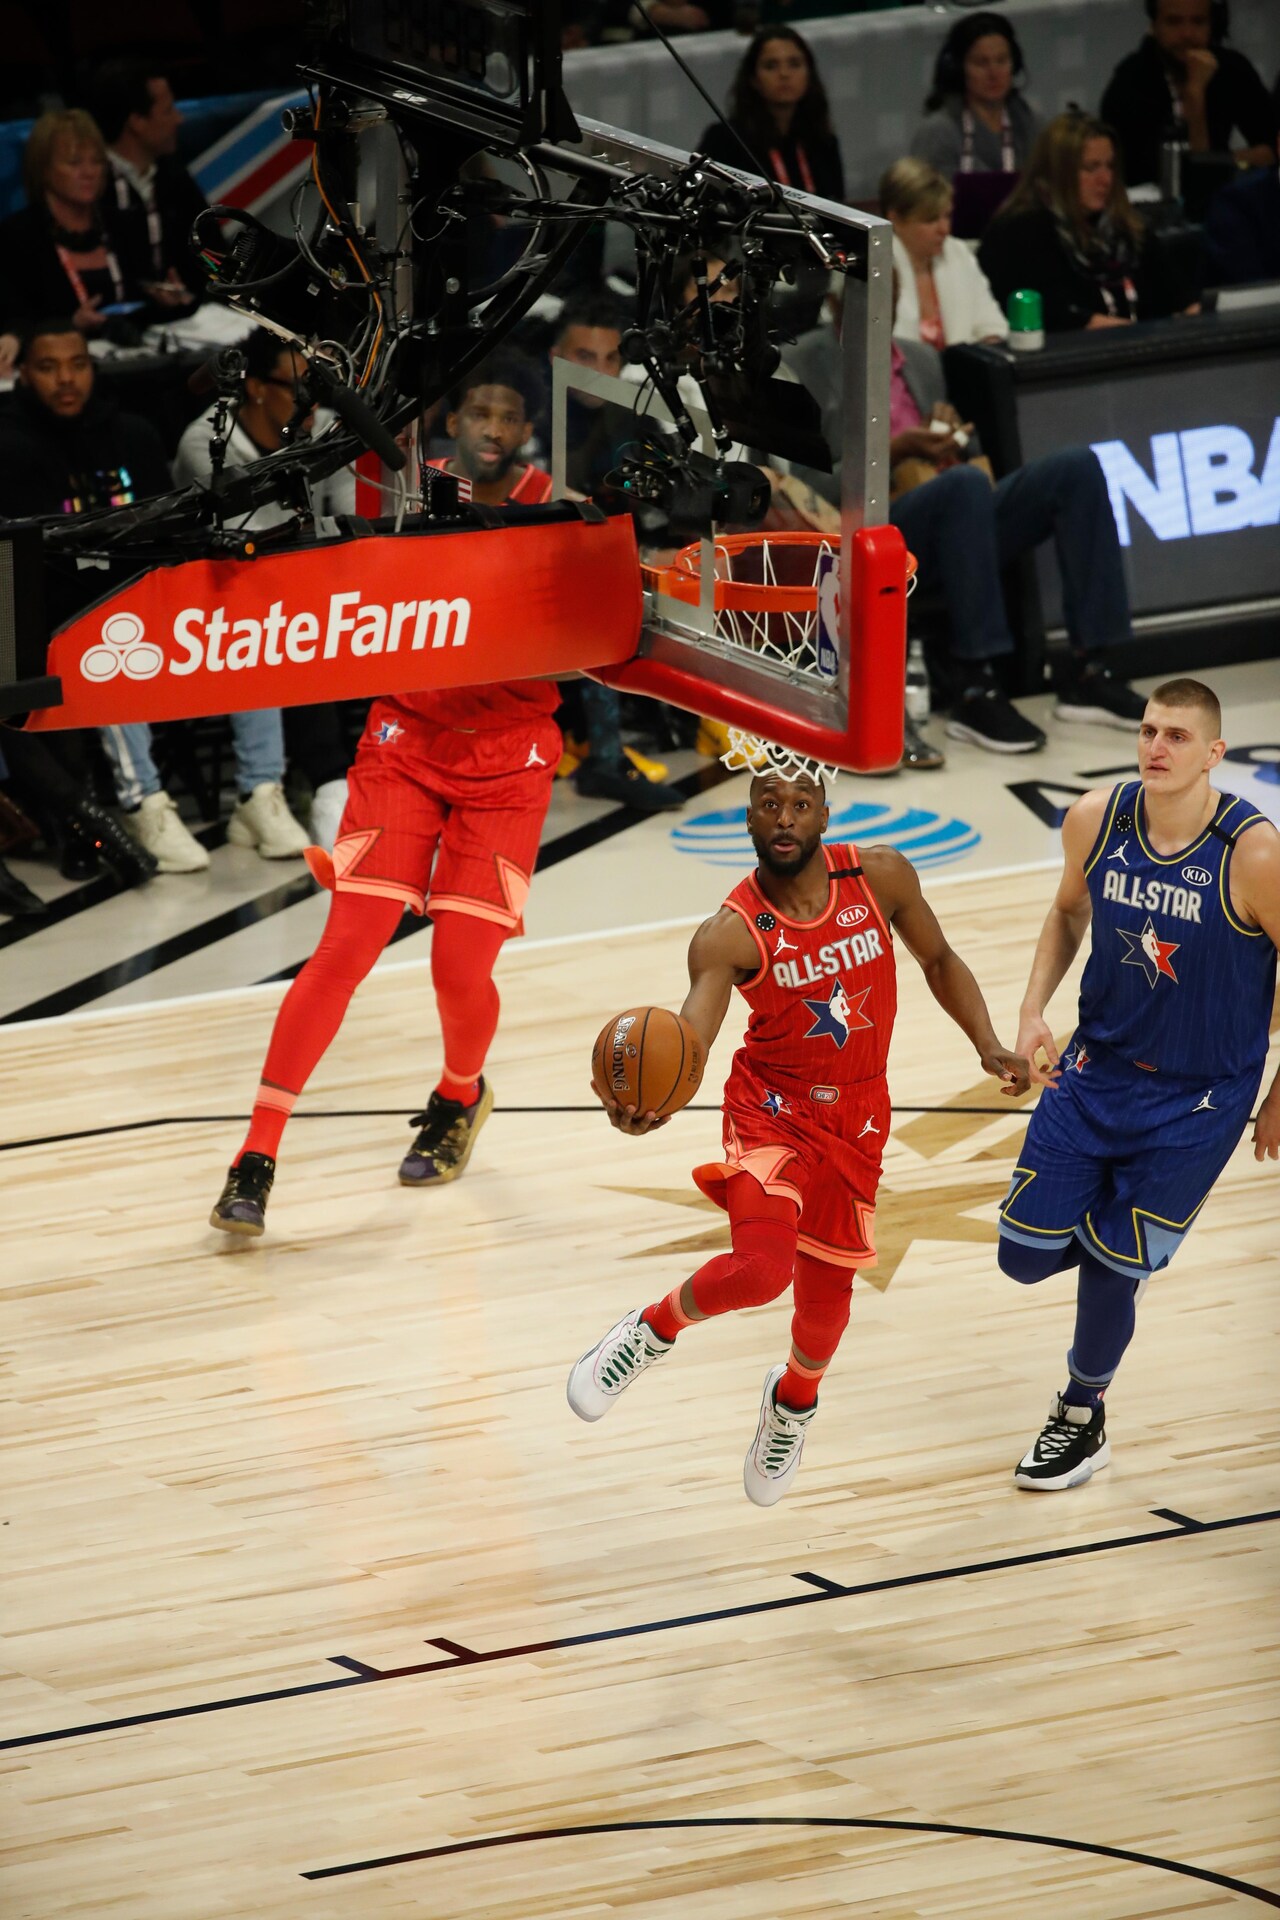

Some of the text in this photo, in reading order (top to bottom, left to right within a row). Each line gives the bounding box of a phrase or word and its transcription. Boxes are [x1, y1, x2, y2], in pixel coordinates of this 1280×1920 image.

[1103, 870, 1202, 924] ALL-STAR
[1185, 868, 1208, 885] KIA
[840, 907, 865, 926] KIA
[772, 928, 884, 989] ALL-STAR
[612, 1016, 636, 1091] SPALDING
